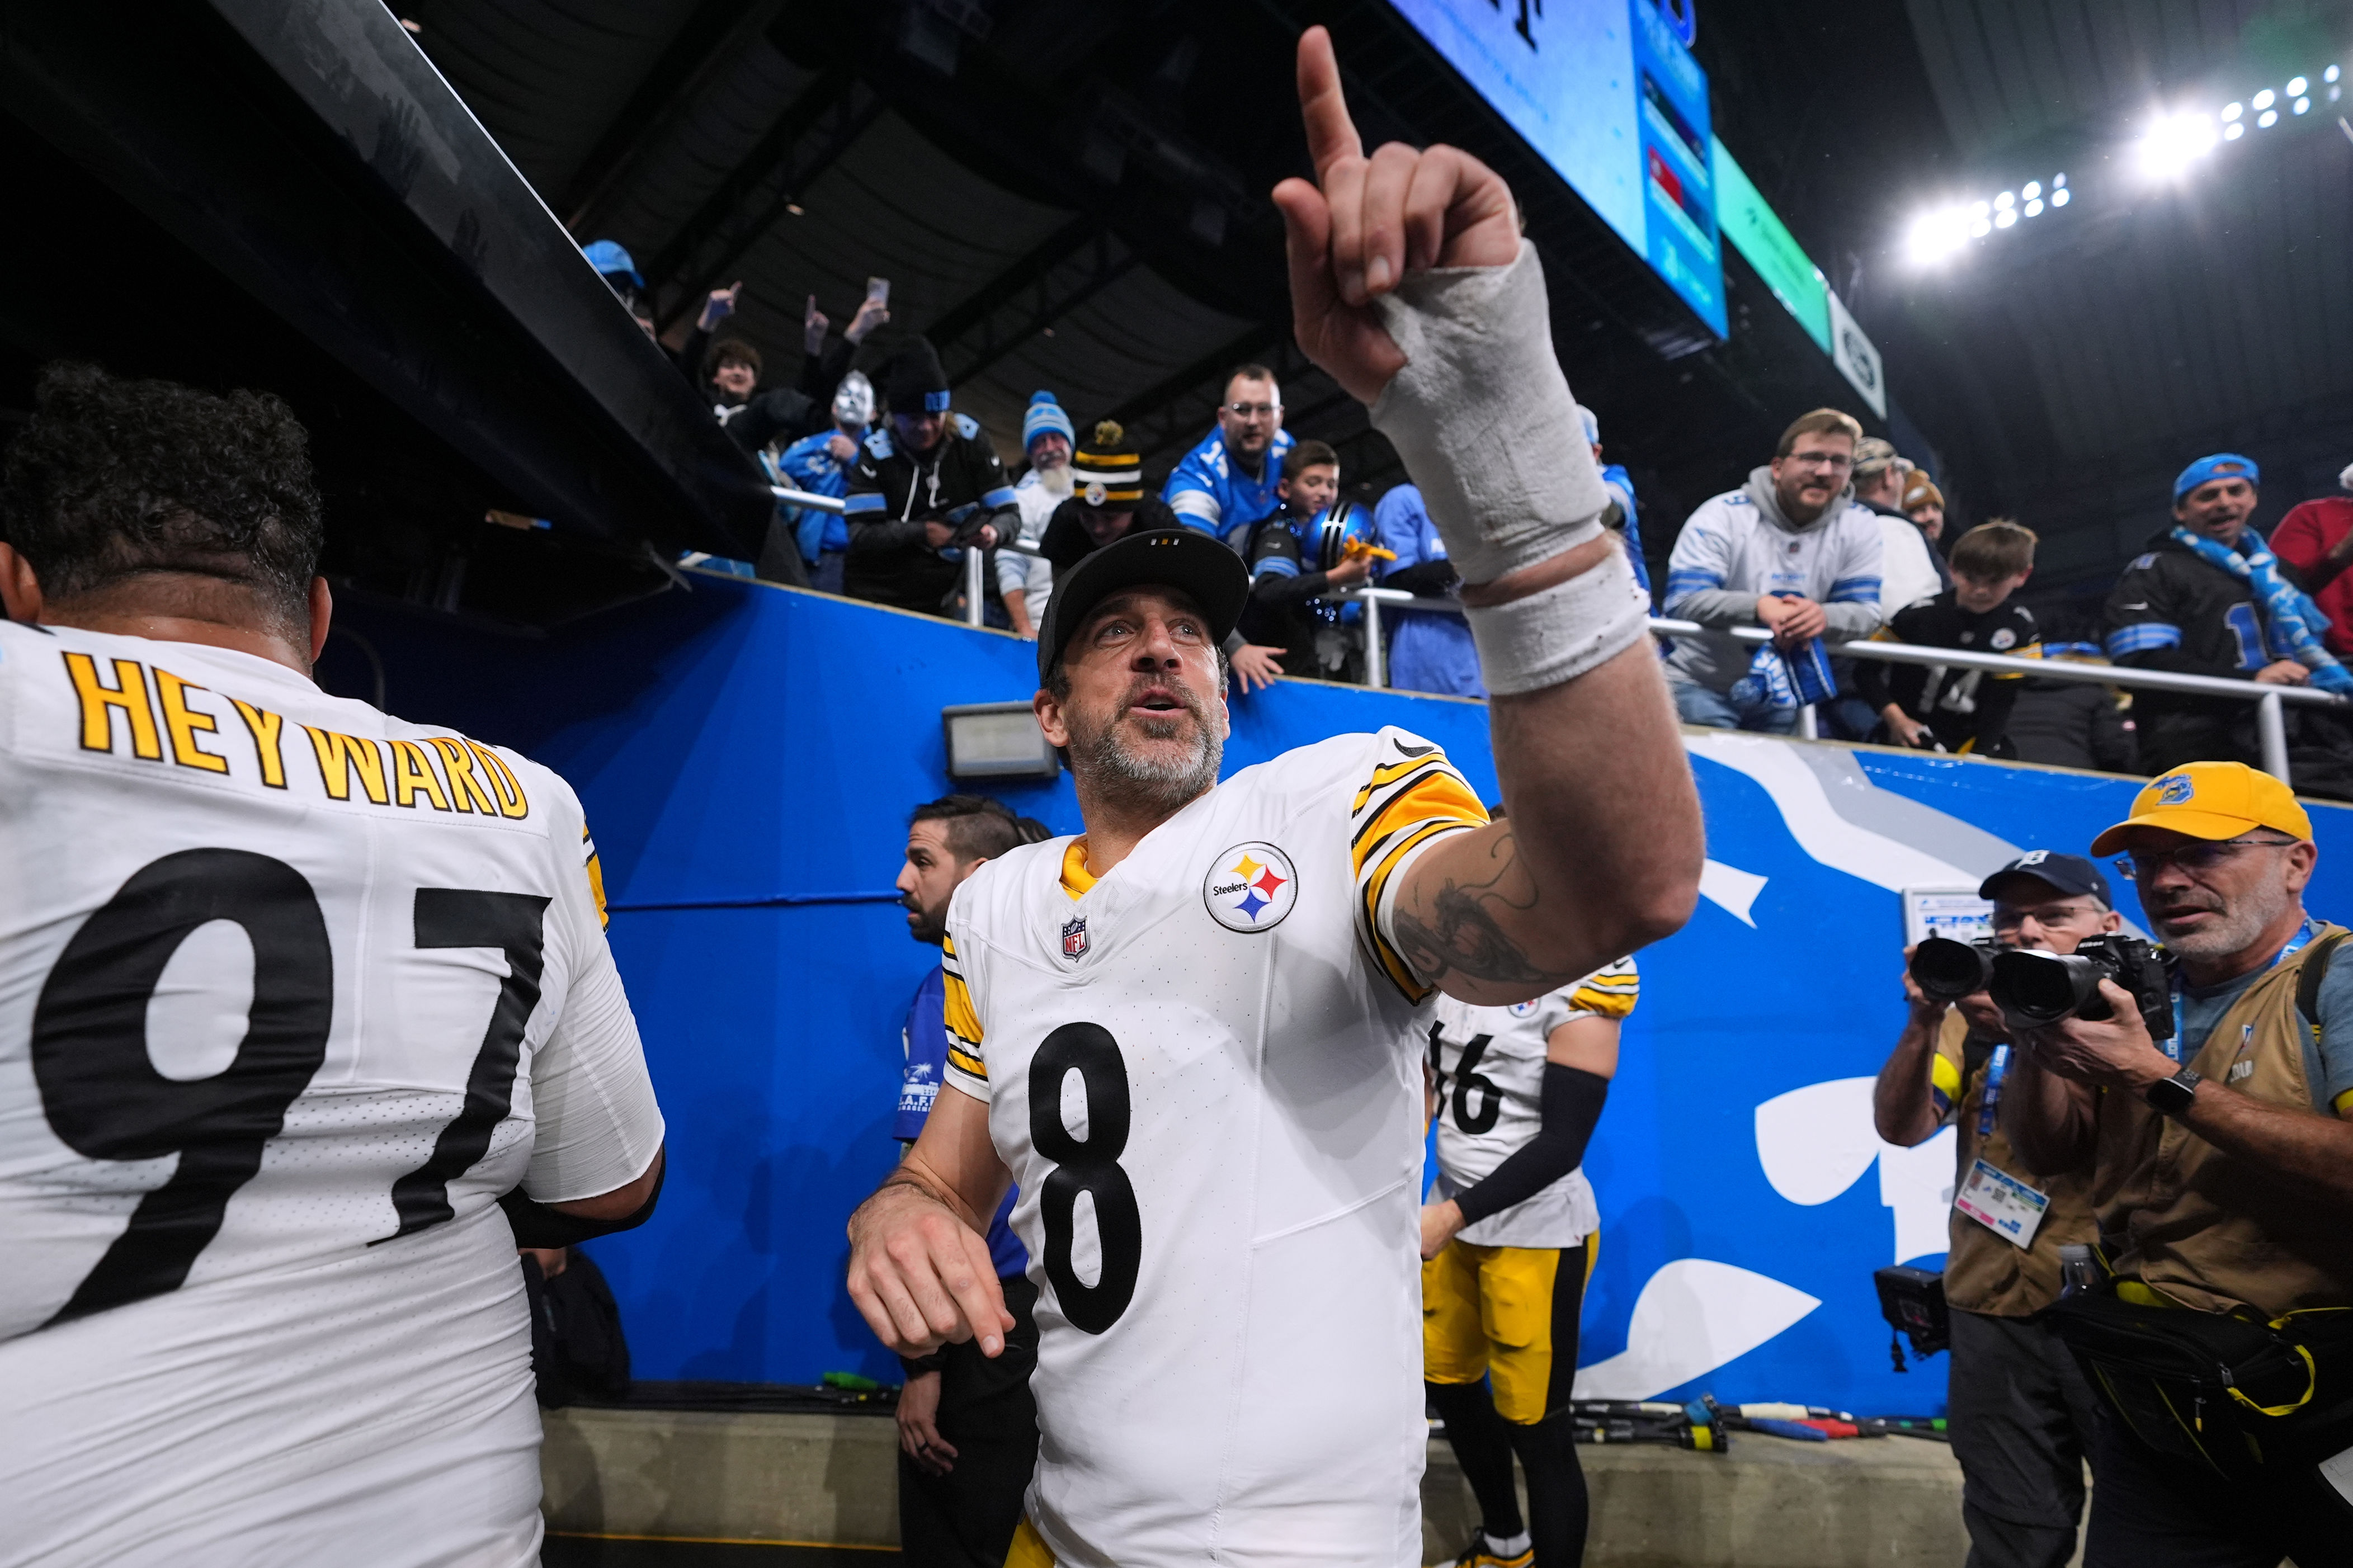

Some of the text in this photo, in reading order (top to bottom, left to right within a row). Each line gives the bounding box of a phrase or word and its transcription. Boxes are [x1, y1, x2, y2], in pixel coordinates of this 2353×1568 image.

[61, 650, 529, 820] HEYWARD
[1064, 933, 1086, 953] NFL
[1213, 882, 1248, 896] Steelers
[0, 847, 553, 1334] 97
[1029, 1021, 1142, 1335] 8
